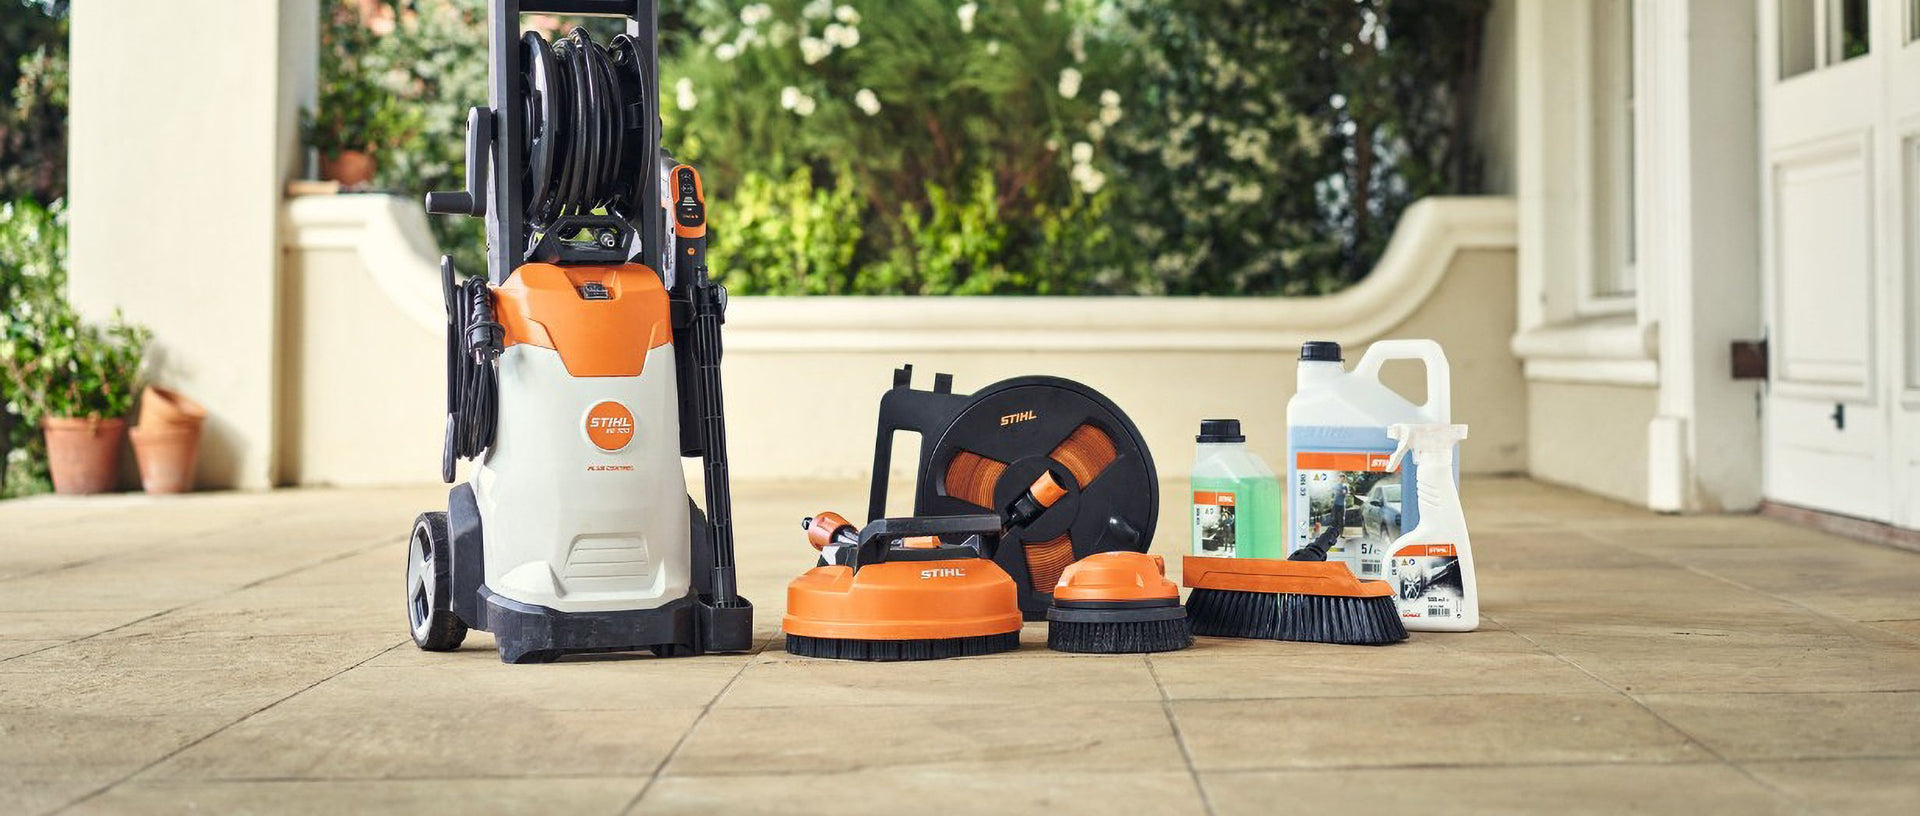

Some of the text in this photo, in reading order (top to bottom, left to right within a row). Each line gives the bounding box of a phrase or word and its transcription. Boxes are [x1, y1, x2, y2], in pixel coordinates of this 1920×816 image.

[590, 417, 631, 428] STIHL
[1000, 410, 1037, 426] STIHL
[921, 568, 966, 579] STIHL
